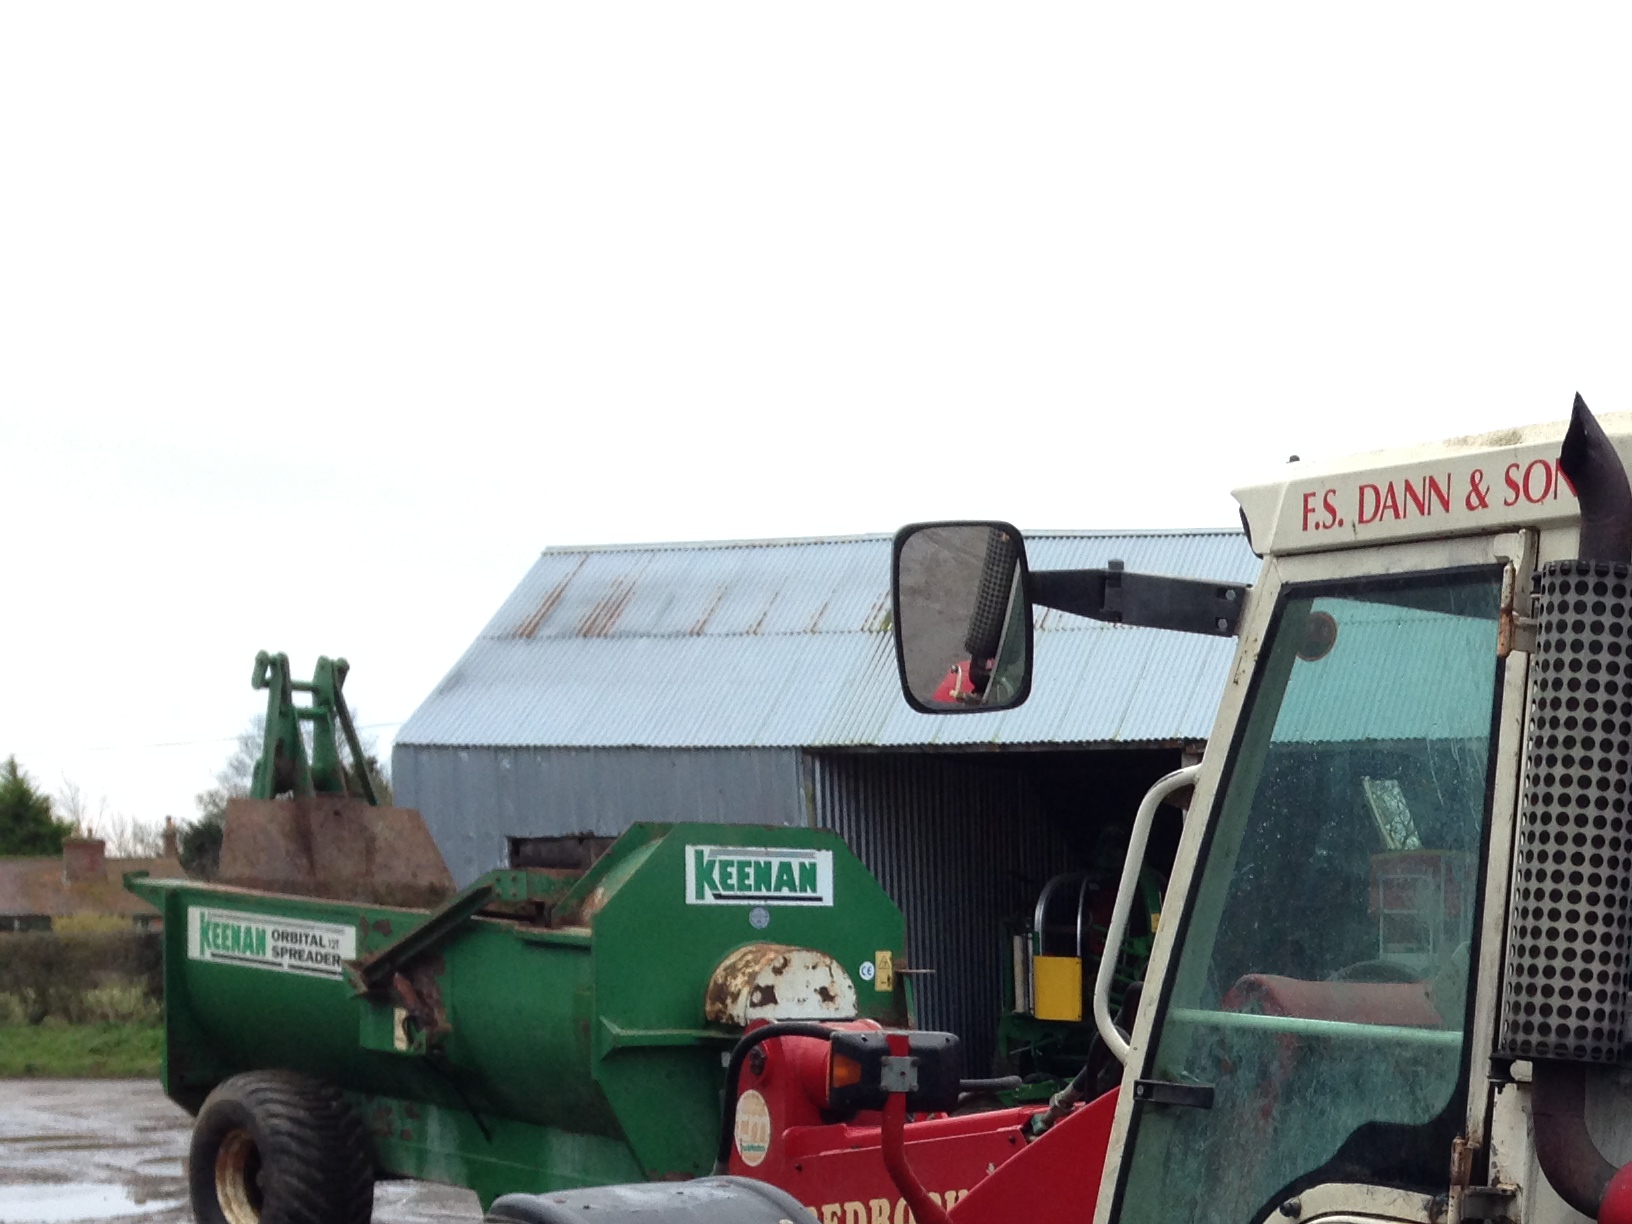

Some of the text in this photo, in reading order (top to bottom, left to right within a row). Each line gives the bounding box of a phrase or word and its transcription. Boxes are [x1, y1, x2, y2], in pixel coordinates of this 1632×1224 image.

[1301, 488, 1344, 532] F.S.
[1357, 472, 1452, 525] DANN
[1465, 467, 1491, 512] &
[694, 849, 818, 900] KEENAN
[200, 910, 267, 957] KEENAN
[271, 929, 326, 949] ORBITAL
[271, 945, 341, 968] SPREADER
